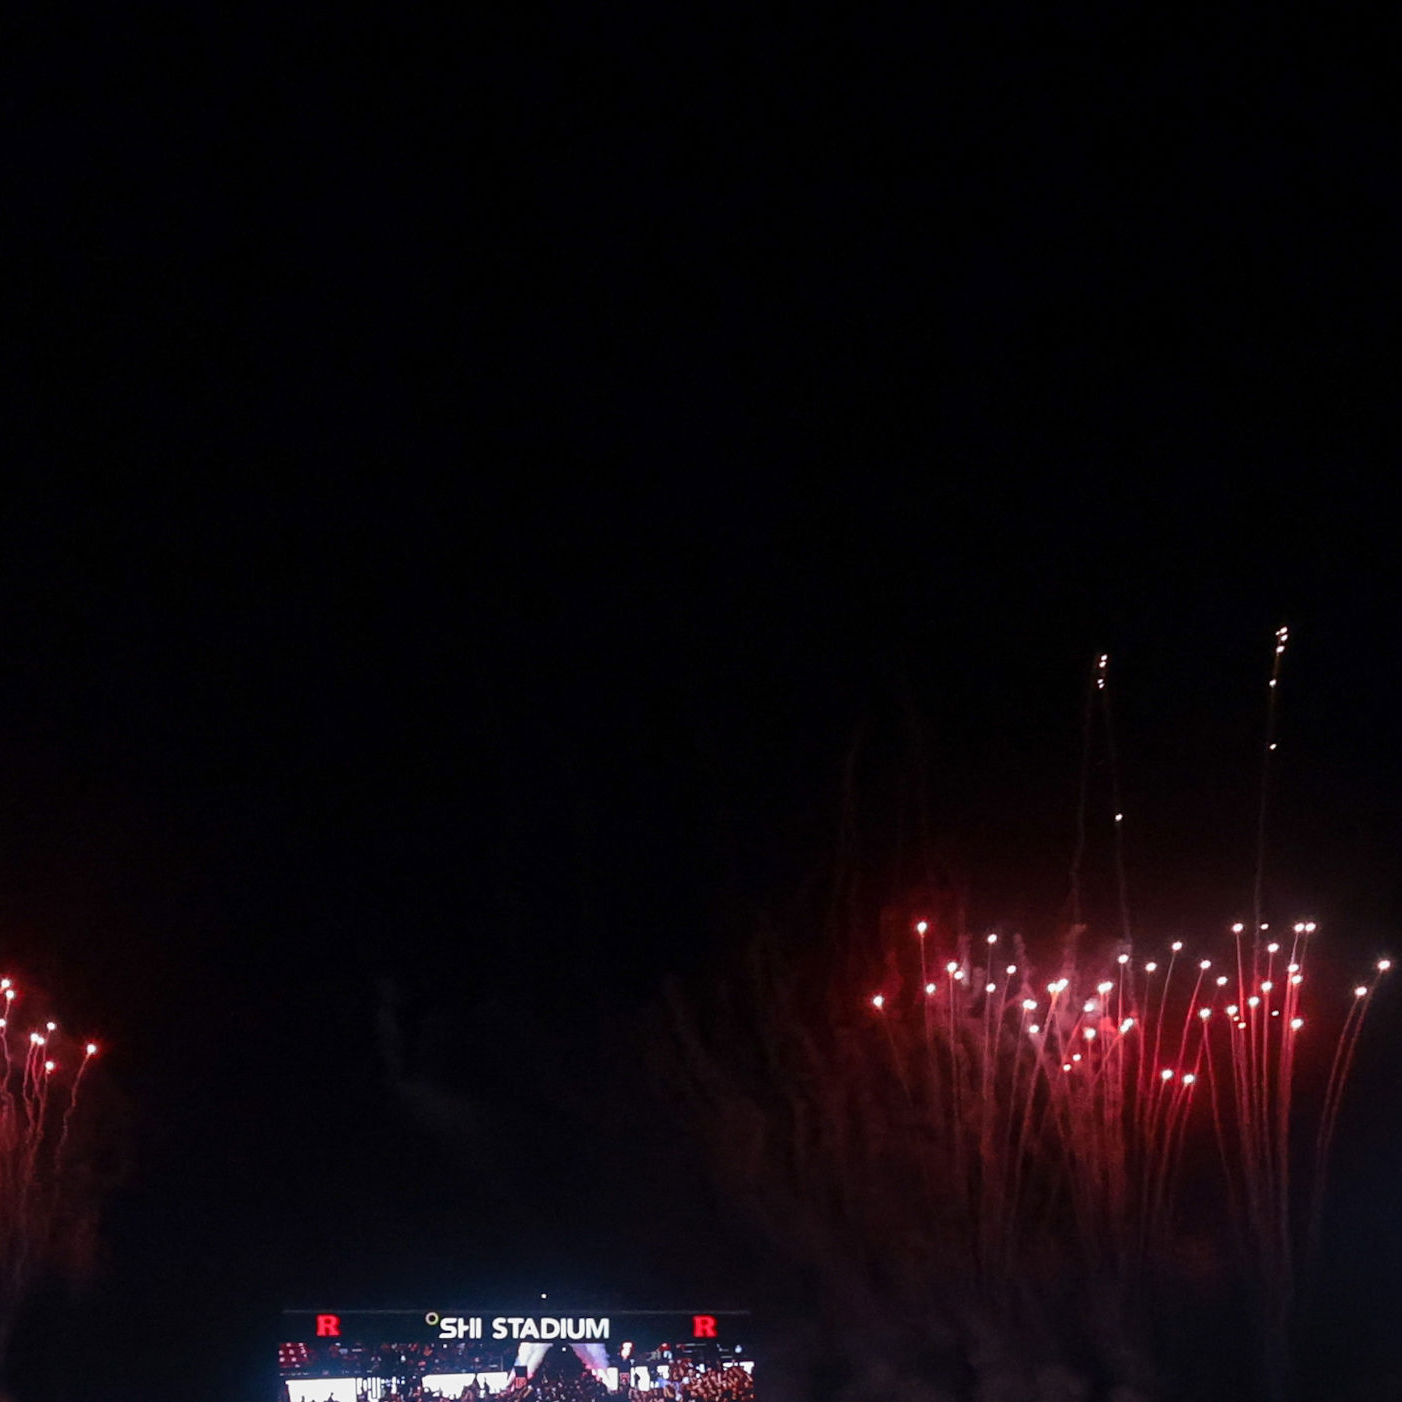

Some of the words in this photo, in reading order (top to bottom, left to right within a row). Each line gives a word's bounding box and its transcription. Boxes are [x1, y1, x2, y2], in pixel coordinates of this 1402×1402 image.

[316, 1313, 341, 1338] R
[439, 1317, 482, 1339] SHI
[492, 1317, 610, 1340] STADIUM
[692, 1314, 718, 1339] R
